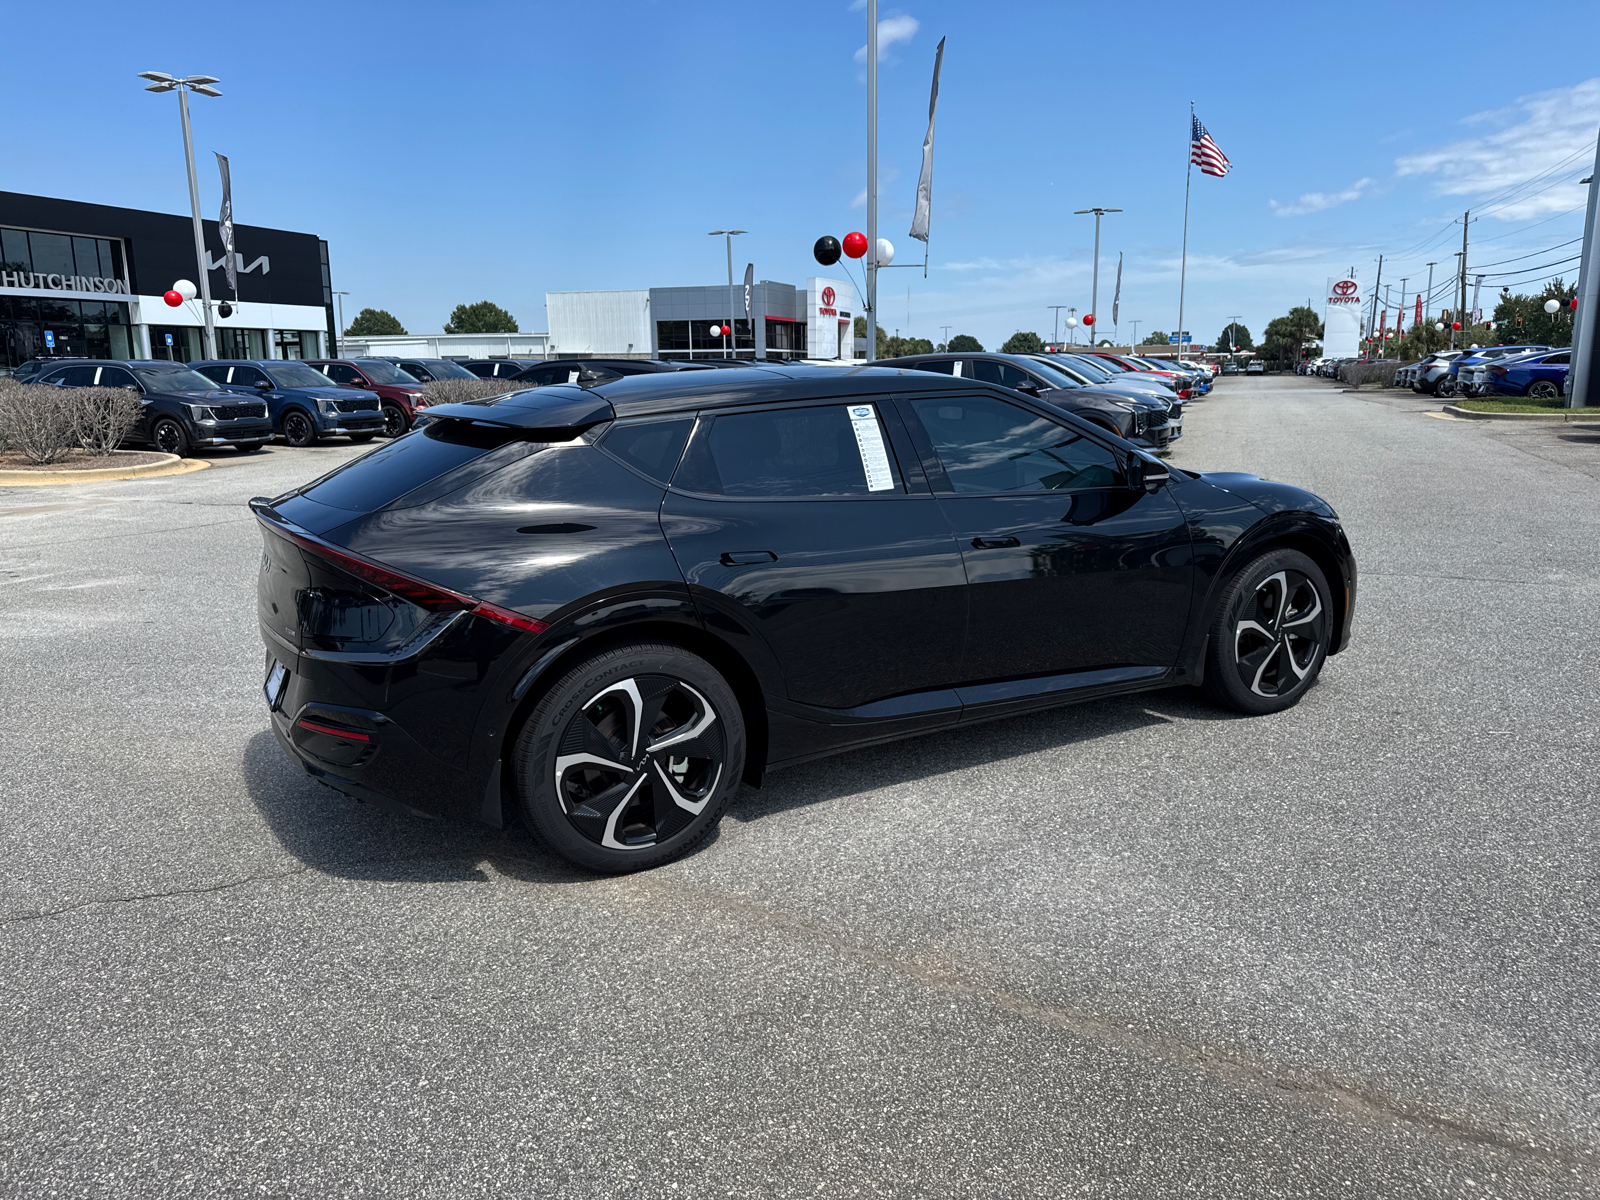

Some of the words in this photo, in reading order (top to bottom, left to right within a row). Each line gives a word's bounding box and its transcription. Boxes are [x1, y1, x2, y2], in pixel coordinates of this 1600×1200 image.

[1, 270, 130, 295] HUTCHINSON
[1328, 296, 1361, 304] TOYOTA
[819, 307, 837, 317] TOYOTA
